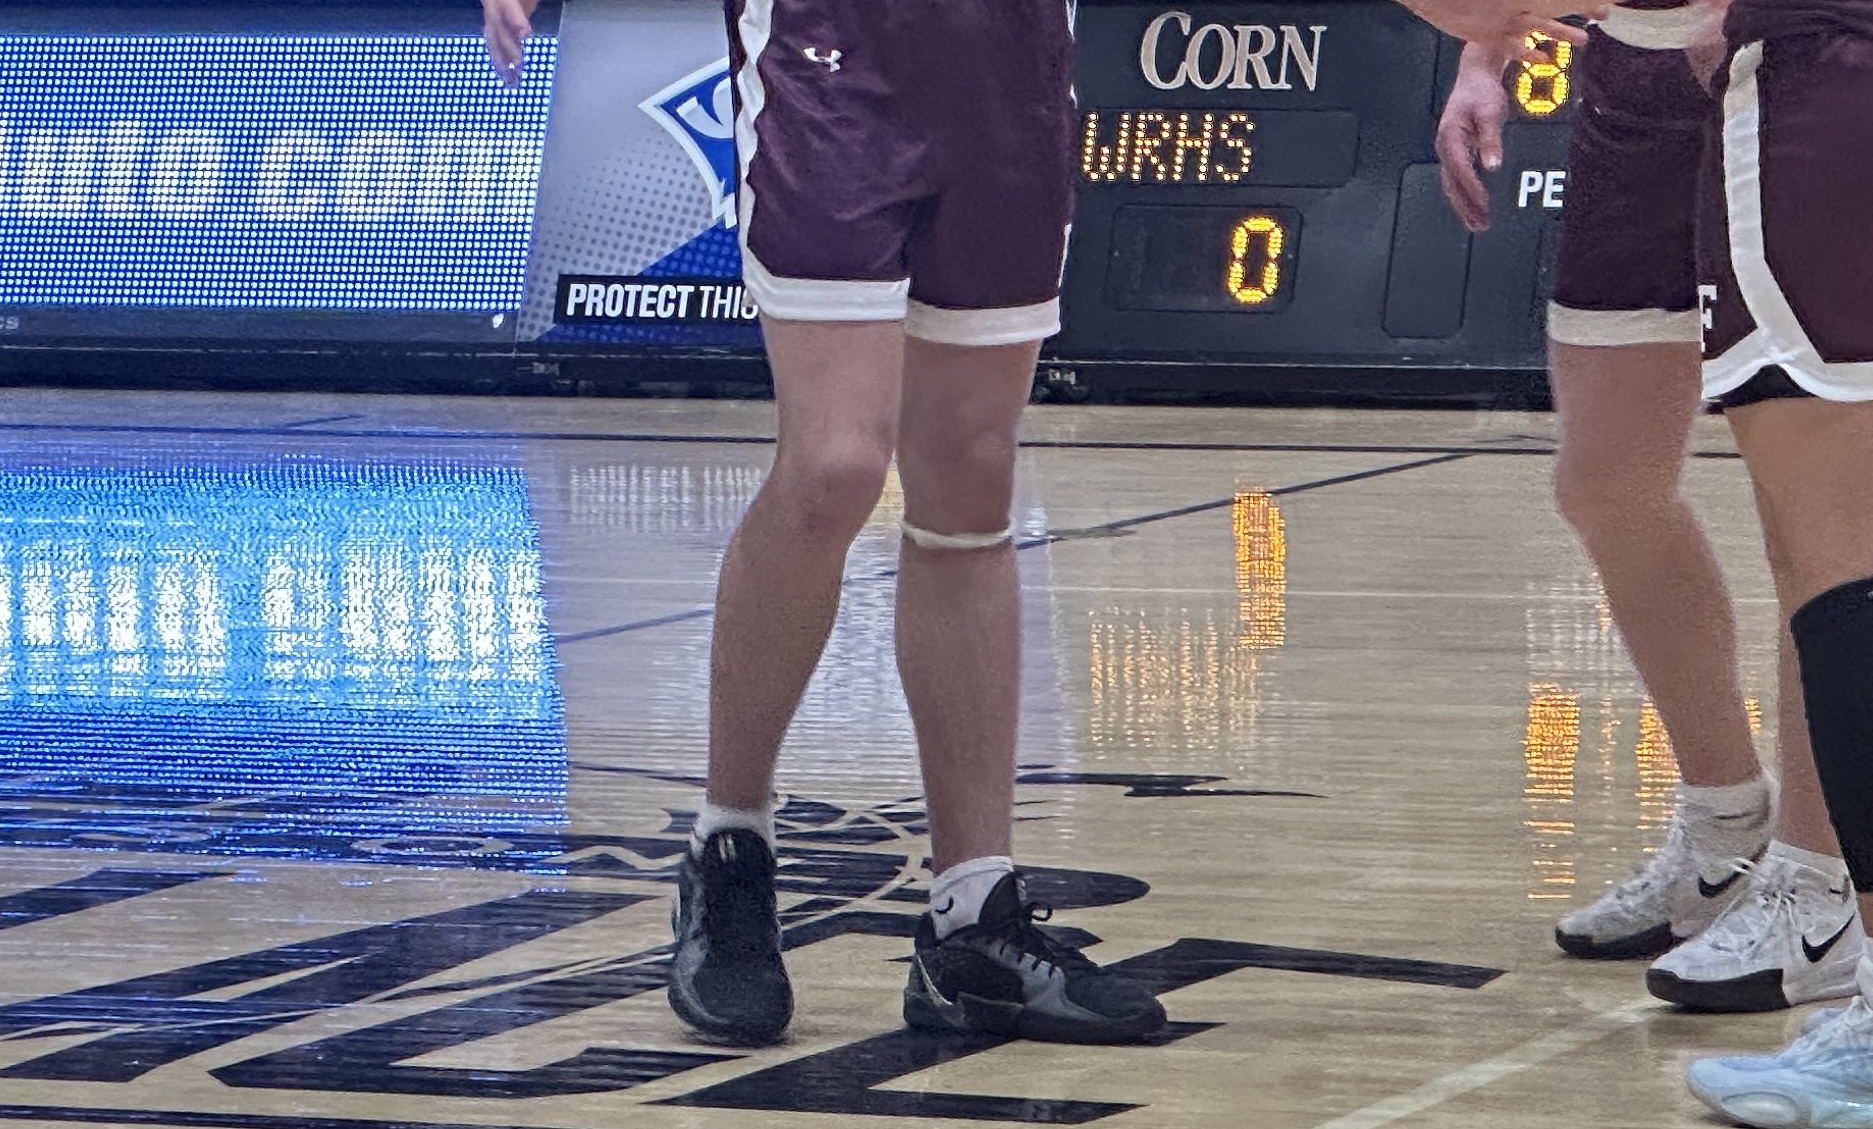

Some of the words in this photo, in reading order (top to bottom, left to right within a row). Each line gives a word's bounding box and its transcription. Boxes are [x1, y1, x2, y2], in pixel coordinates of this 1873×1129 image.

[1140, 10, 1327, 92] CORN
[1082, 111, 1255, 182] WRHS
[1226, 216, 1285, 304] 0
[566, 283, 695, 319] PROTECT
